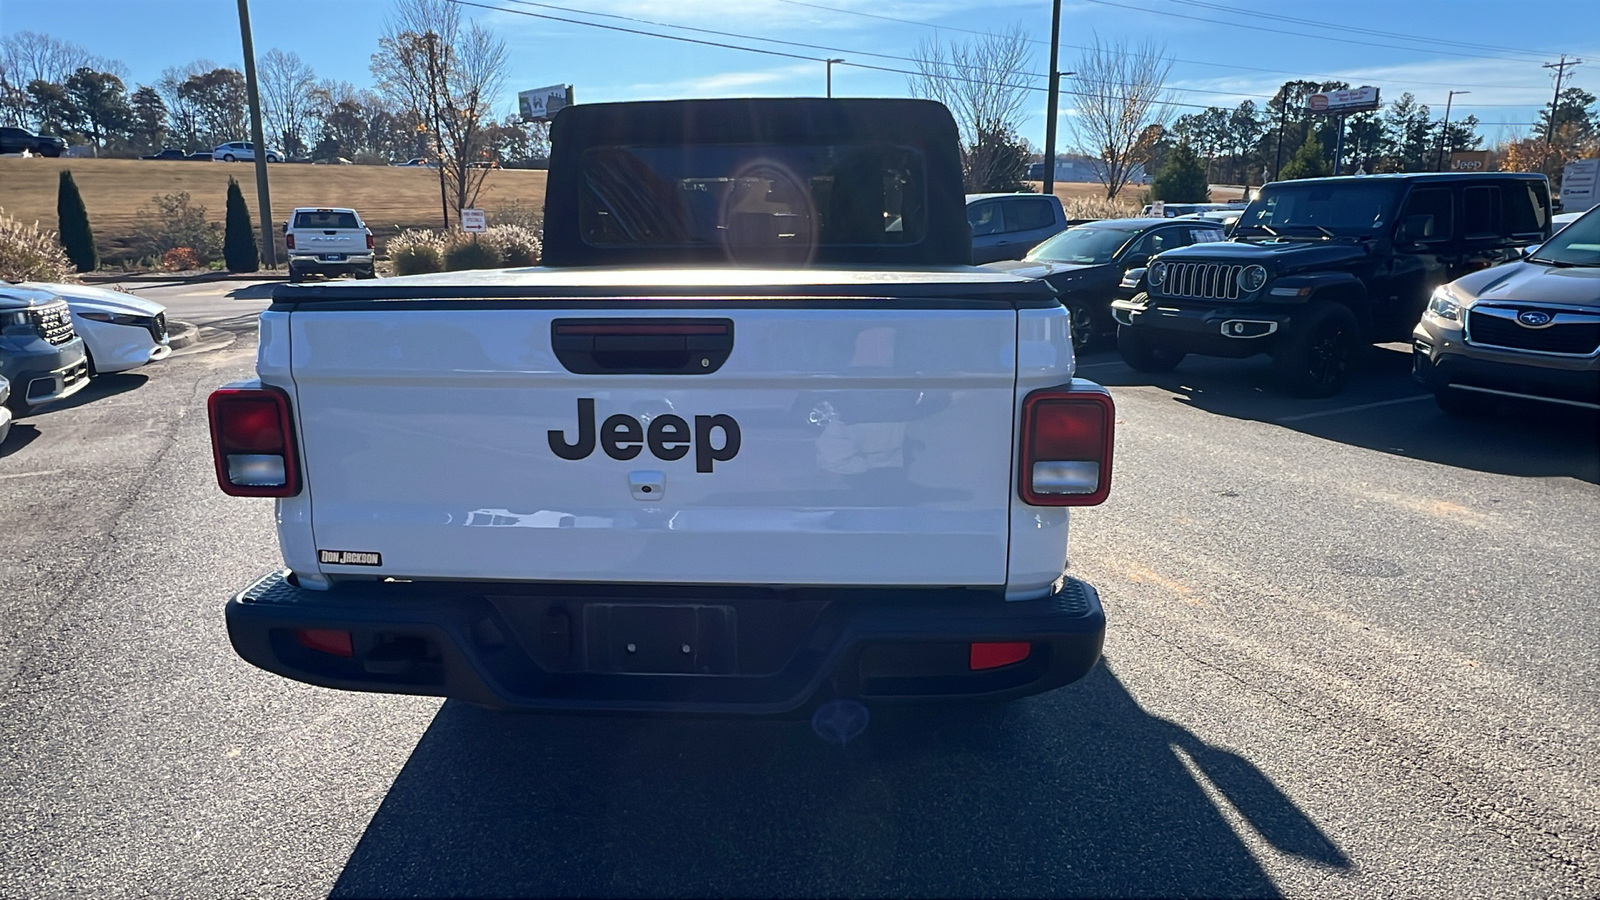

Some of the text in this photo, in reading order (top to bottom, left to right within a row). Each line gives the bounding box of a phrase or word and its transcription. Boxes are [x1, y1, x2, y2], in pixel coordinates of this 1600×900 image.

[1451, 160, 1482, 170] Jeep
[547, 398, 741, 473] Jeep
[321, 551, 379, 564] DON JACKSON
